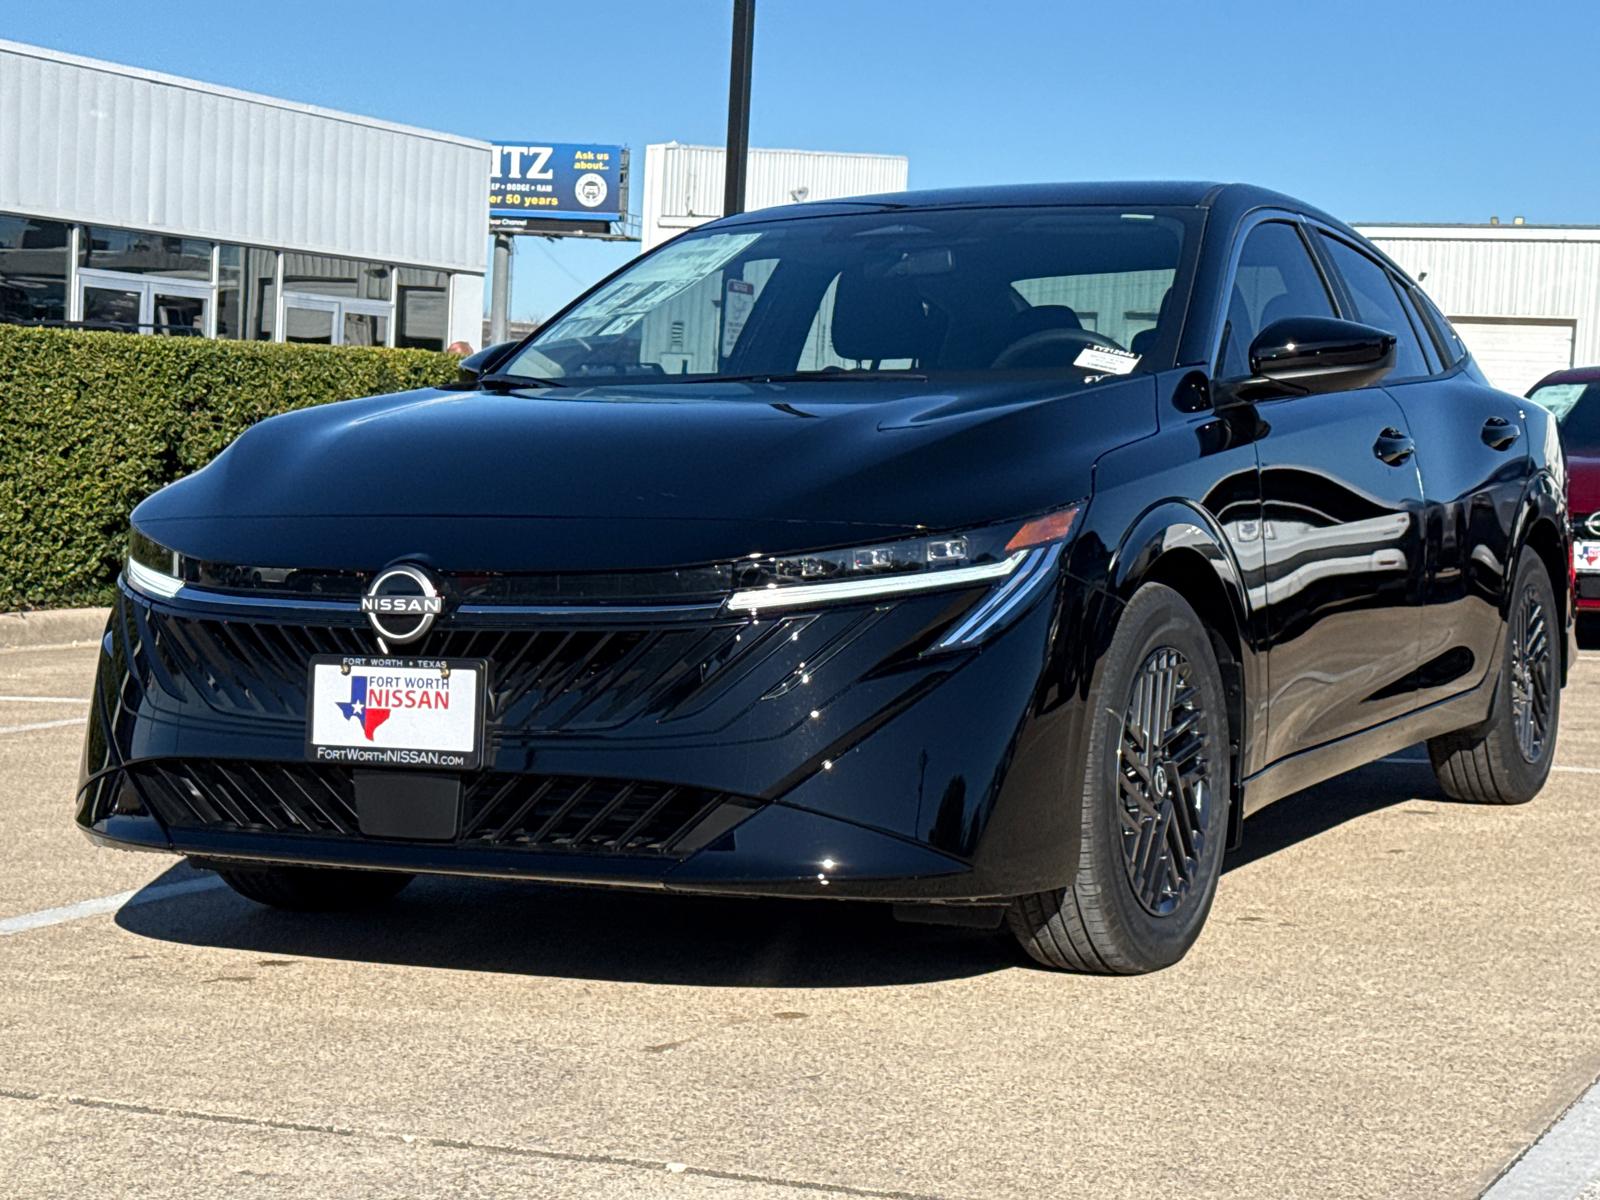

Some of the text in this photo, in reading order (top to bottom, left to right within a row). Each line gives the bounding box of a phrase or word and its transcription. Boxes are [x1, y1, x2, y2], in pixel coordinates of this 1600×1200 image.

[575, 151, 594, 160] Ask
[507, 183, 530, 192] DODGE
[537, 184, 552, 192] RAM
[506, 194, 520, 204] 50
[524, 197, 558, 207] years
[362, 598, 439, 611] NISSAN
[343, 657, 447, 669] FORT WORTH TEXAS
[369, 676, 450, 690] FORT WORTH
[368, 689, 450, 710] NISSAN
